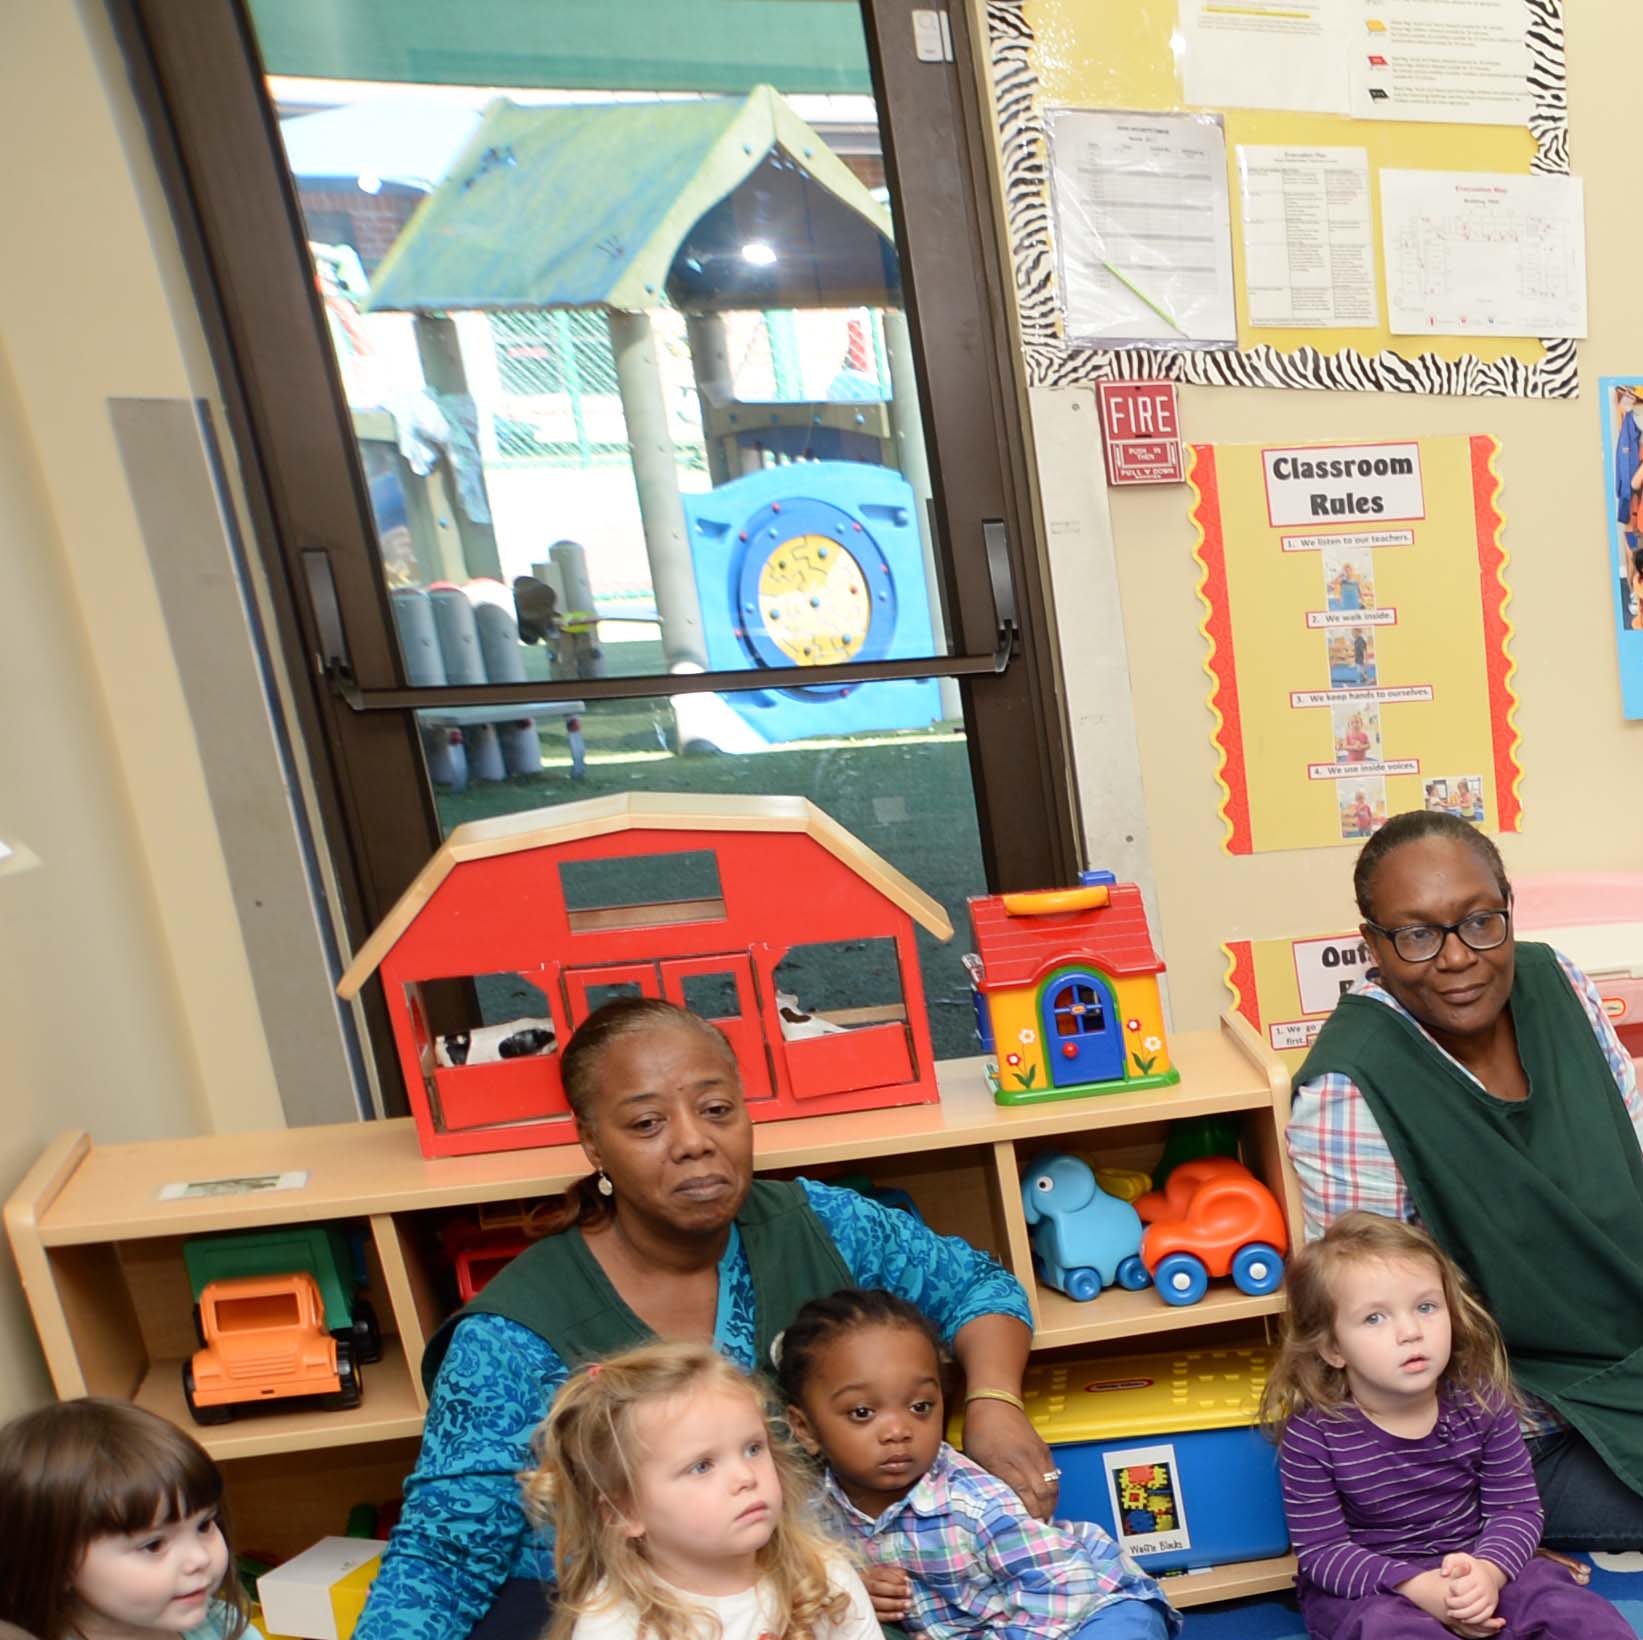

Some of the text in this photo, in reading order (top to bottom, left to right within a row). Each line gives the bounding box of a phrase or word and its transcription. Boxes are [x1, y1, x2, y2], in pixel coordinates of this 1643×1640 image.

[1110, 396, 1172, 434] FIRE
[1272, 456, 1414, 480] Classroom
[1310, 493, 1384, 516] Rules
[1301, 539, 1315, 547] We
[1317, 537, 1341, 547] listen
[1343, 537, 1353, 545] to
[1342, 613, 1361, 621] walk
[1364, 612, 1392, 621] inside.
[1310, 695, 1324, 703] We
[1327, 693, 1347, 703] keep
[1349, 691, 1375, 700] hands
[1388, 688, 1429, 698] ourselves.
[1360, 763, 1386, 772] inside
[1388, 761, 1415, 771] voices.
[1321, 945, 1371, 968] Out
[1286, 1037, 1305, 1045] first.
[1129, 1540, 1184, 1554] Waffle Blocks
